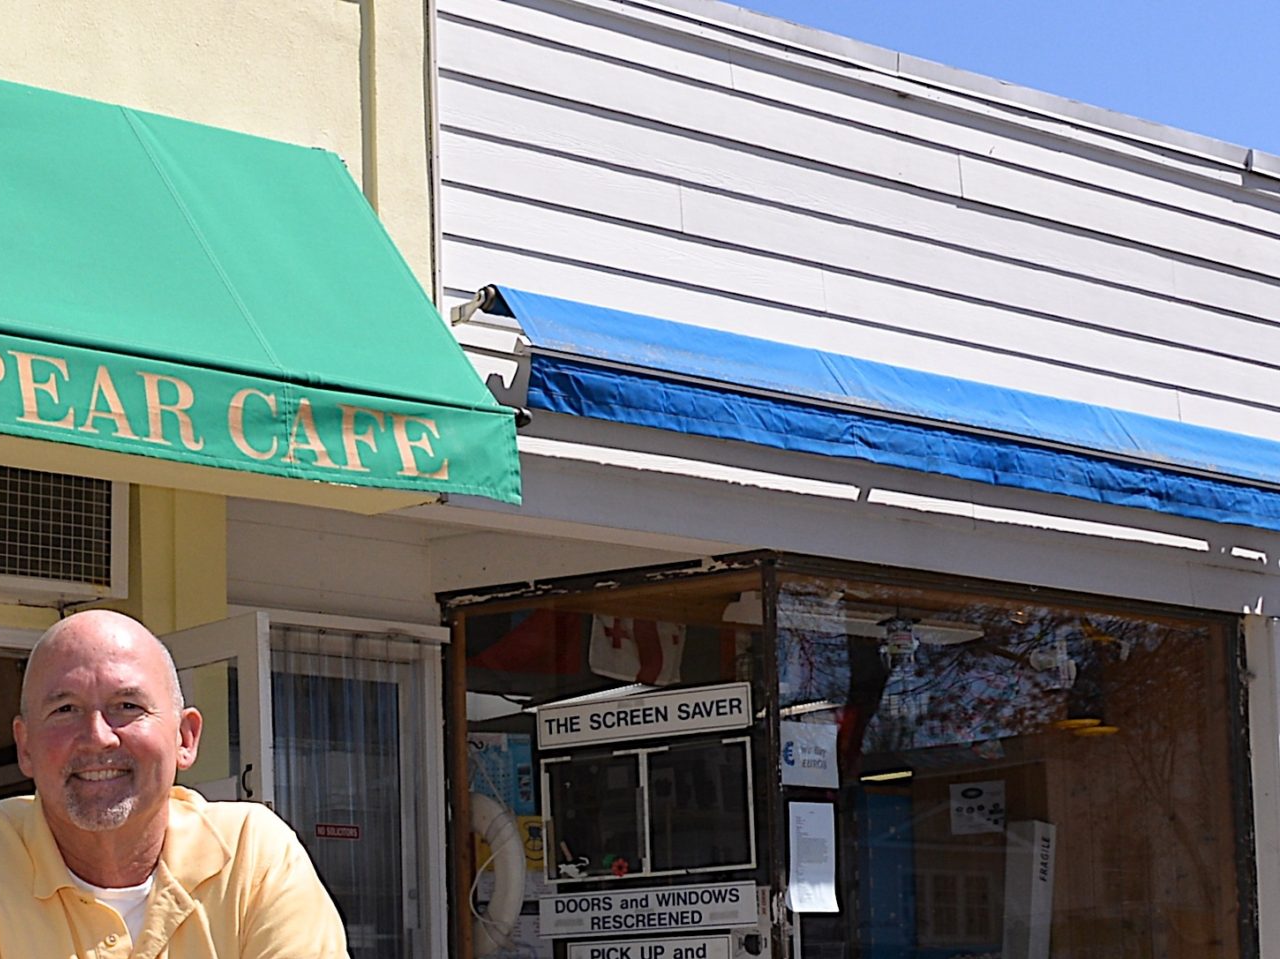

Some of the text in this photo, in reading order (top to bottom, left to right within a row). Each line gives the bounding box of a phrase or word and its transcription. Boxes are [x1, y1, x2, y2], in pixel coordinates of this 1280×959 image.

[227, 387, 449, 480] CAFE
[545, 697, 743, 735] THE SCREEN SAVER
[1039, 836, 1051, 882] FRAGILE
[555, 888, 740, 914] DOORS and WINDOWS
[591, 910, 703, 931] RESCREENED
[673, 943, 707, 959] and
